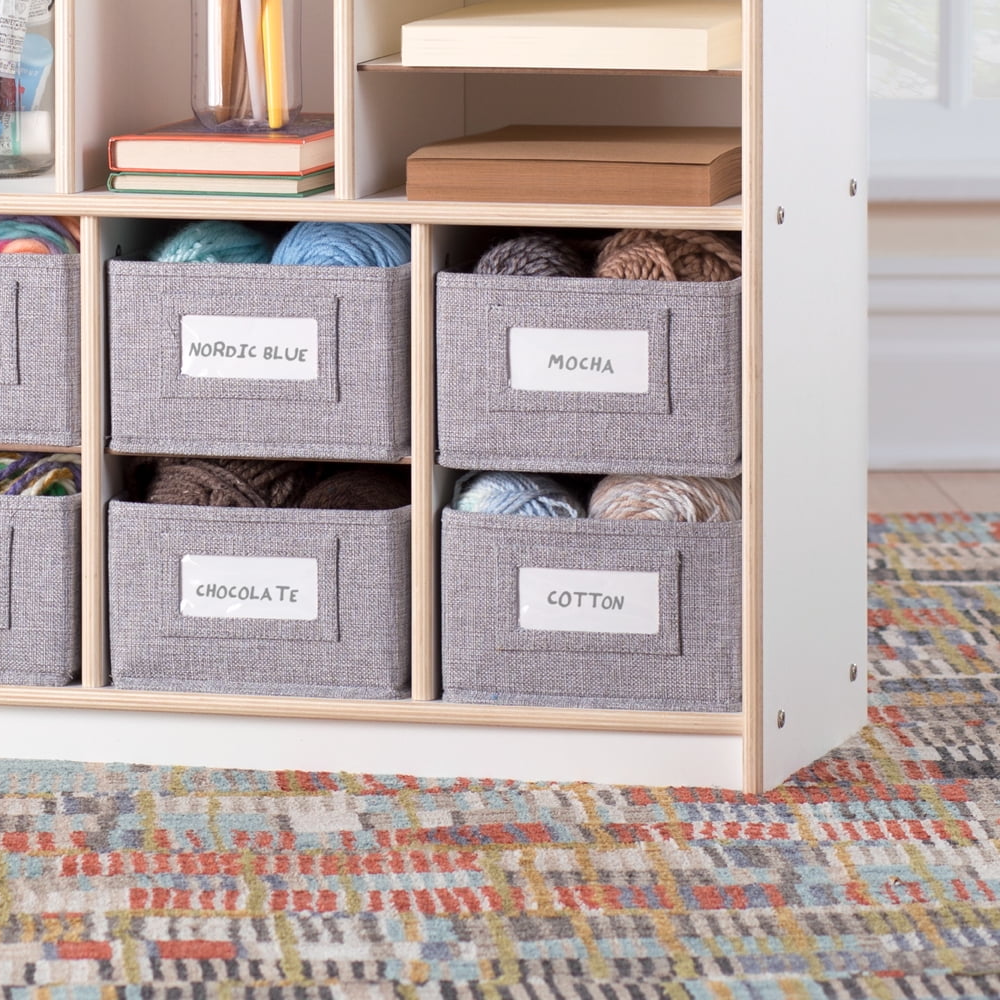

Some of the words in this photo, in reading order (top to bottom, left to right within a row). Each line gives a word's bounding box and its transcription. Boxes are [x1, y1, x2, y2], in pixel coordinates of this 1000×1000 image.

[188, 340, 257, 359] NORDIC
[262, 345, 309, 363] BLUE
[547, 353, 615, 375] MOCHA
[195, 583, 299, 603] CHOCOLATE
[547, 590, 625, 611] COTTON
